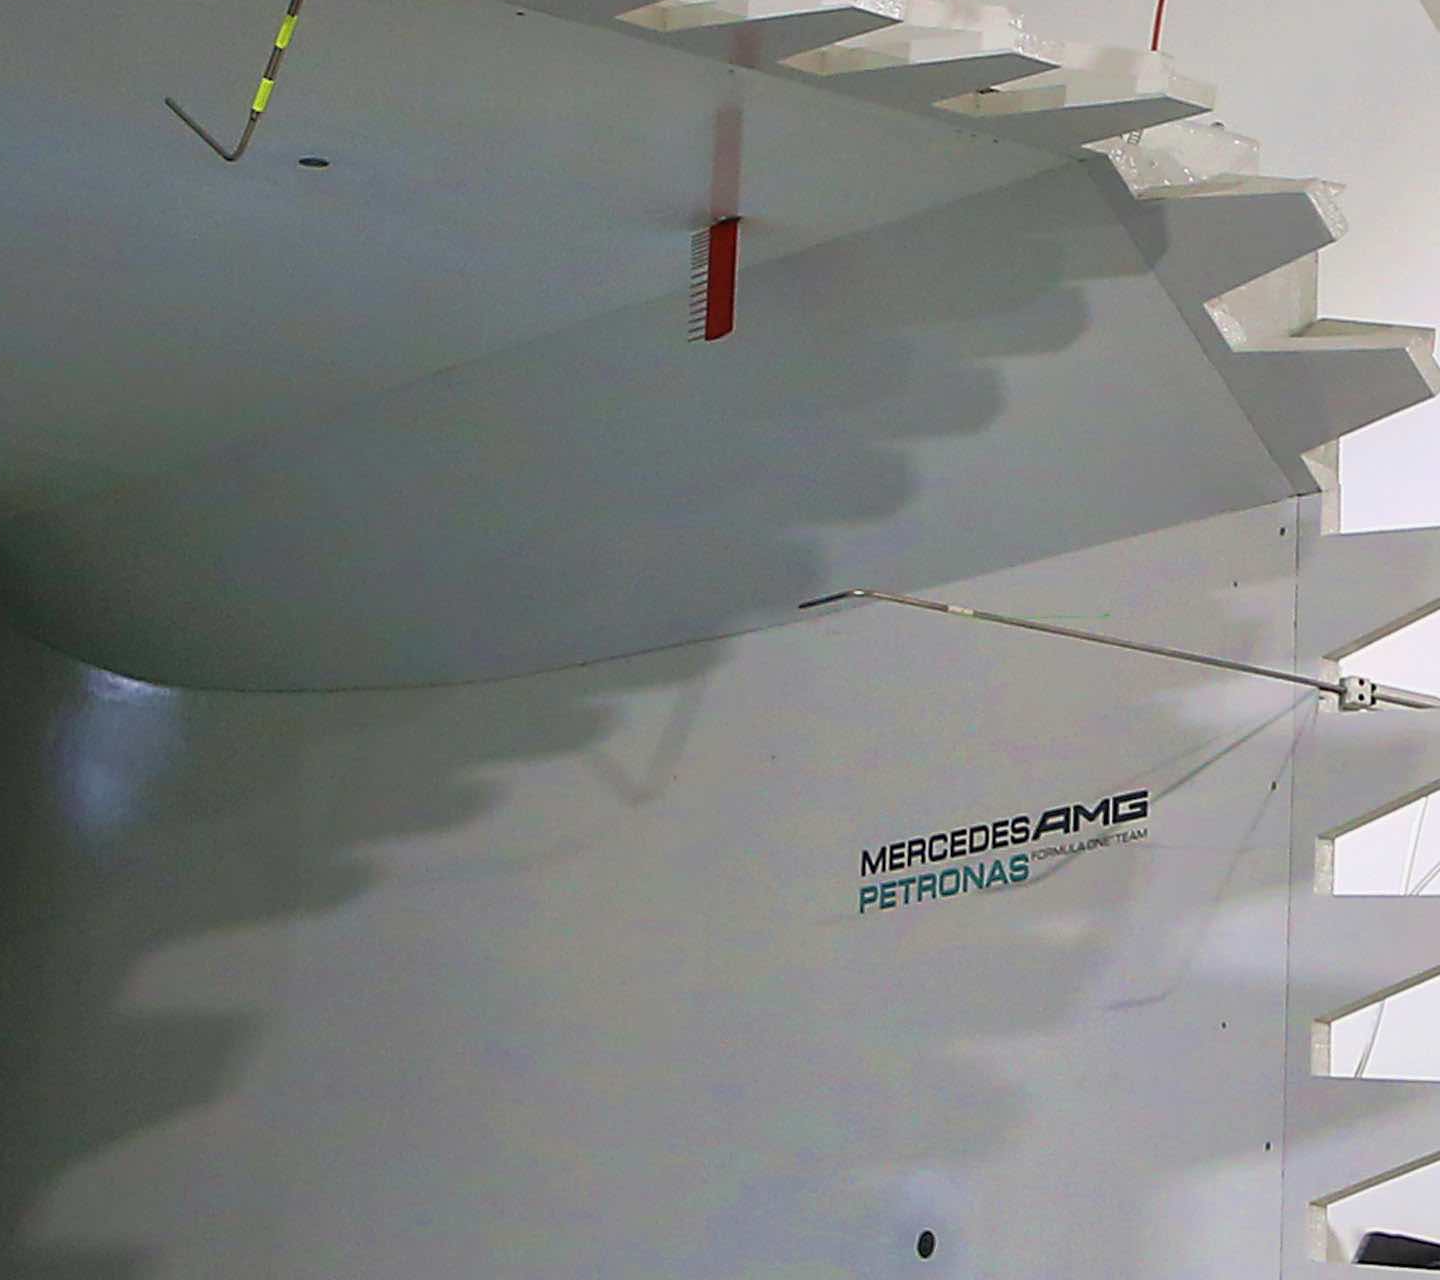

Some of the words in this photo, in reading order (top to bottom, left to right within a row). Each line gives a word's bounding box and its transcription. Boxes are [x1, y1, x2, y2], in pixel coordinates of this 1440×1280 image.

[860, 815, 1030, 877] MERCEDES
[1031, 790, 1148, 841] AMG
[1116, 827, 1148, 844] TEAM
[860, 853, 1030, 913] PETRONAS
